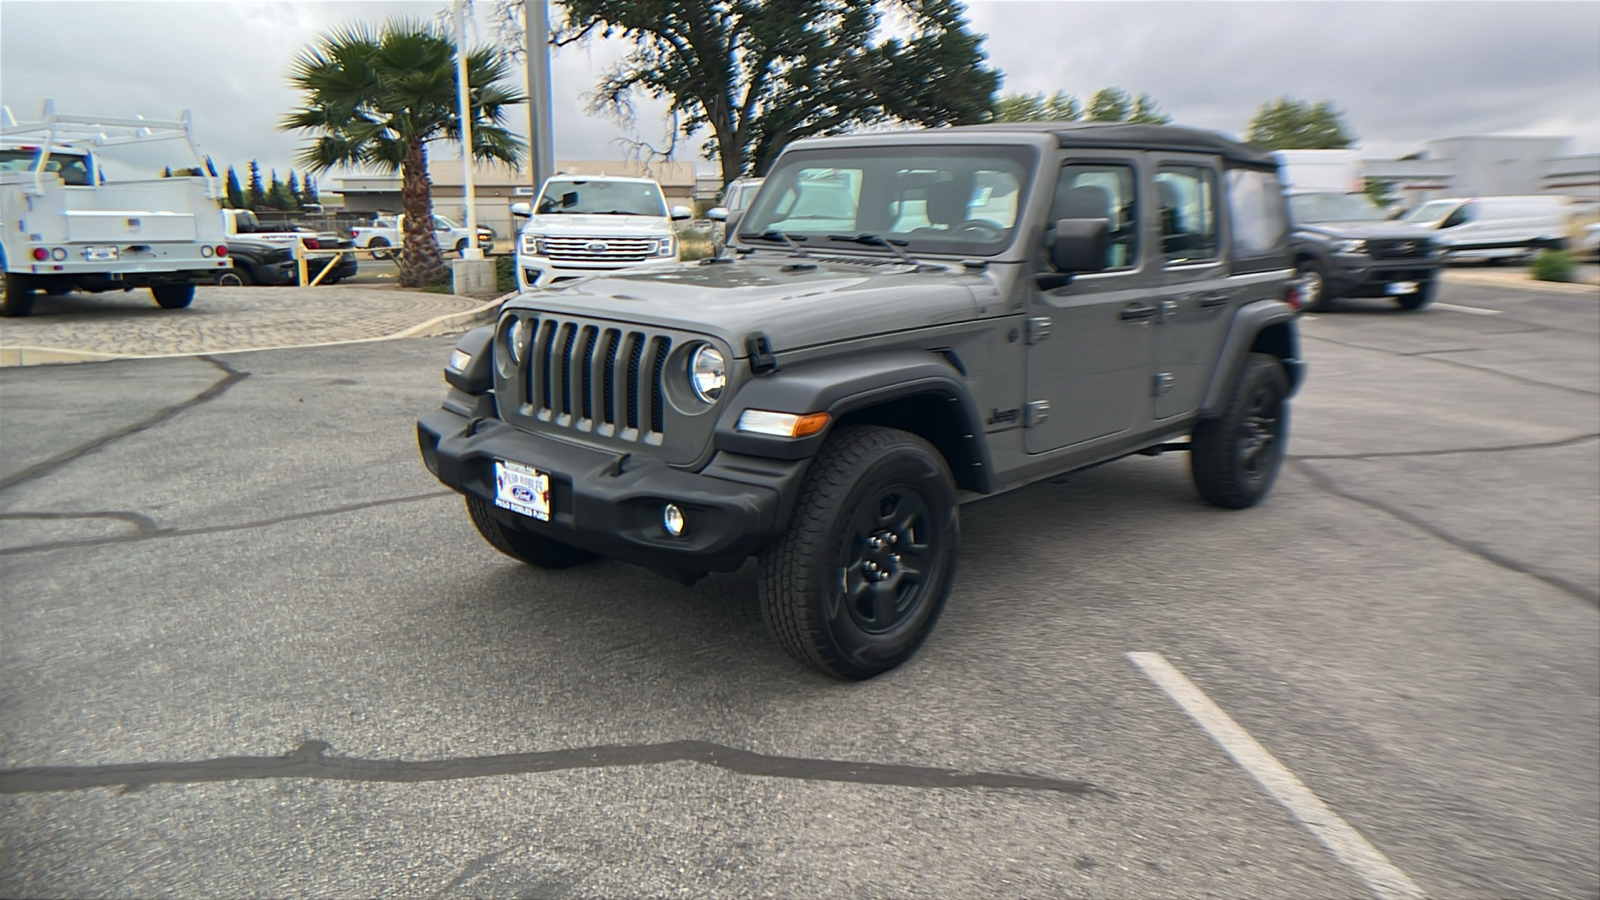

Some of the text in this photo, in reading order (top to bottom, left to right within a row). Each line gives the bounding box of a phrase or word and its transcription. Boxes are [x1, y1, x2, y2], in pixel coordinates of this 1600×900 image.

[986, 407, 1020, 424] Jeep
[503, 470, 544, 494] PASO ROBLES
[513, 487, 533, 502] Ford
